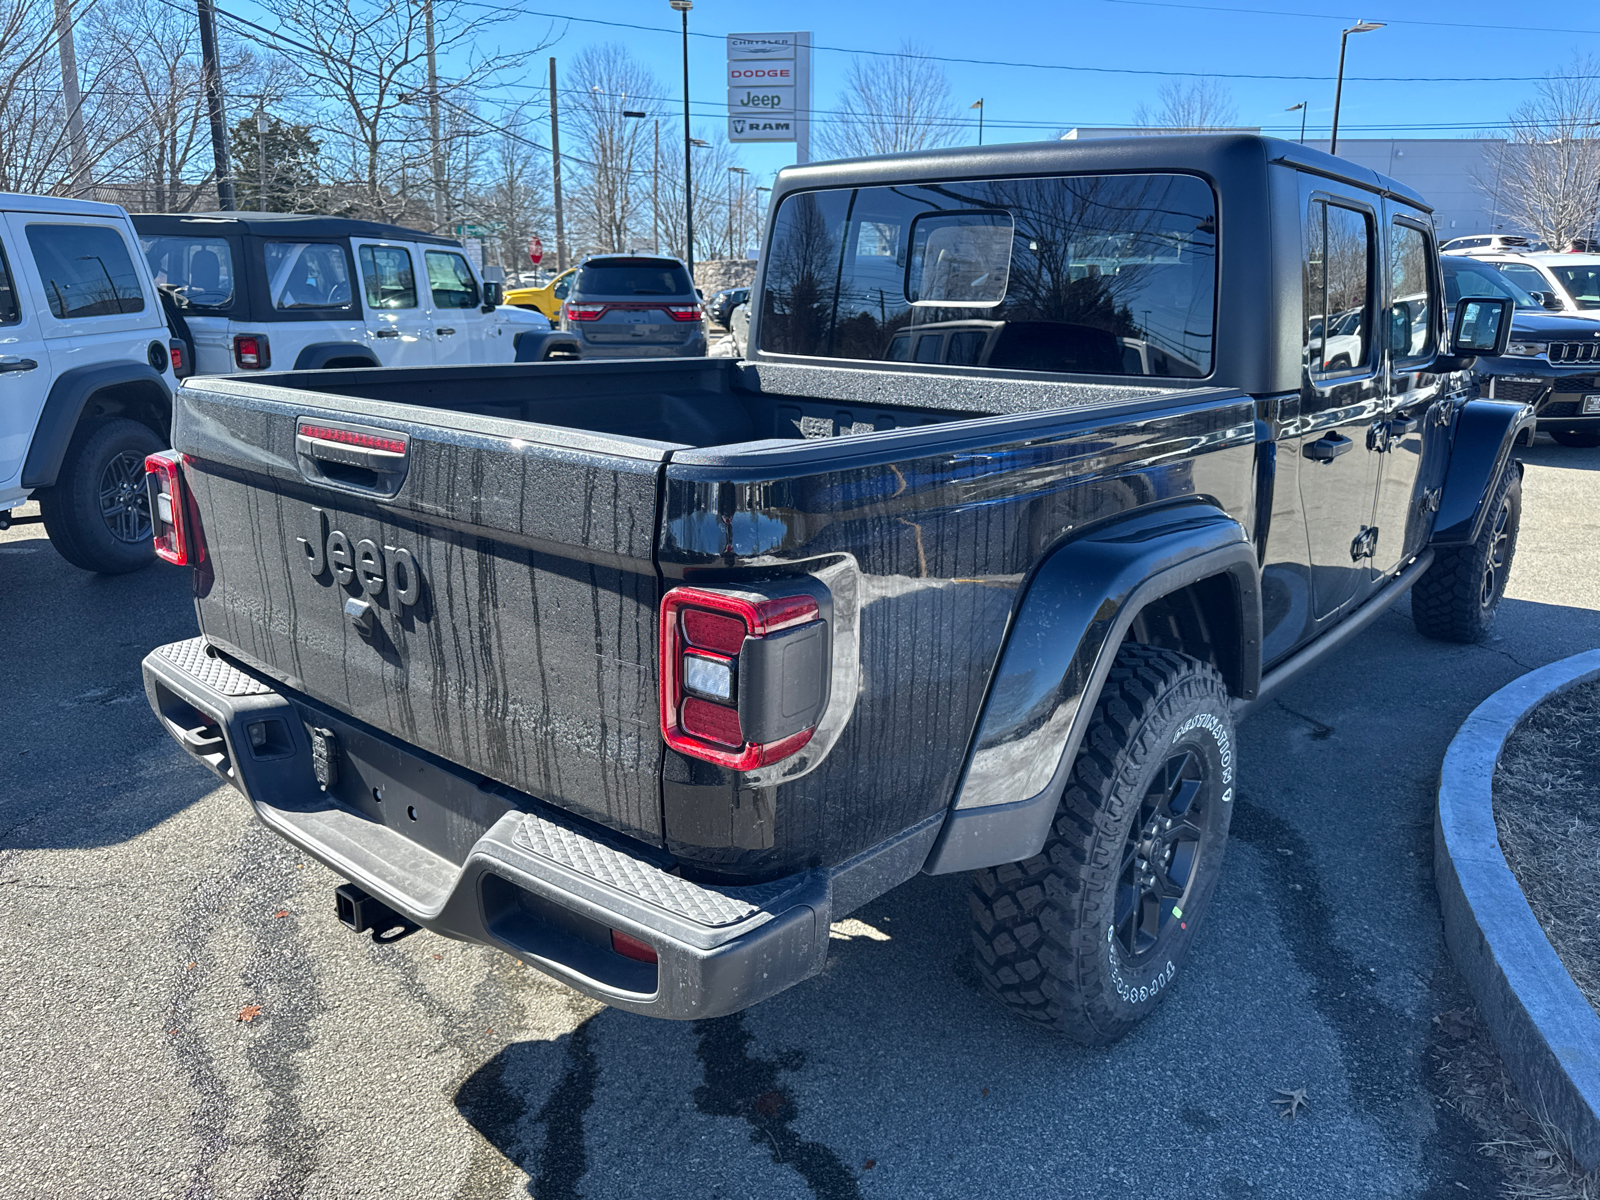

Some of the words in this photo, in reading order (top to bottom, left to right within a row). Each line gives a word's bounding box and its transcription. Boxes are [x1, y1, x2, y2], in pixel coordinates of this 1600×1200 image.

[731, 69, 790, 78] DODGE
[740, 91, 781, 109] Jeep
[748, 123, 790, 131] RAM
[296, 506, 421, 618] Jeep
[1172, 713, 1233, 785] DESTINATION
